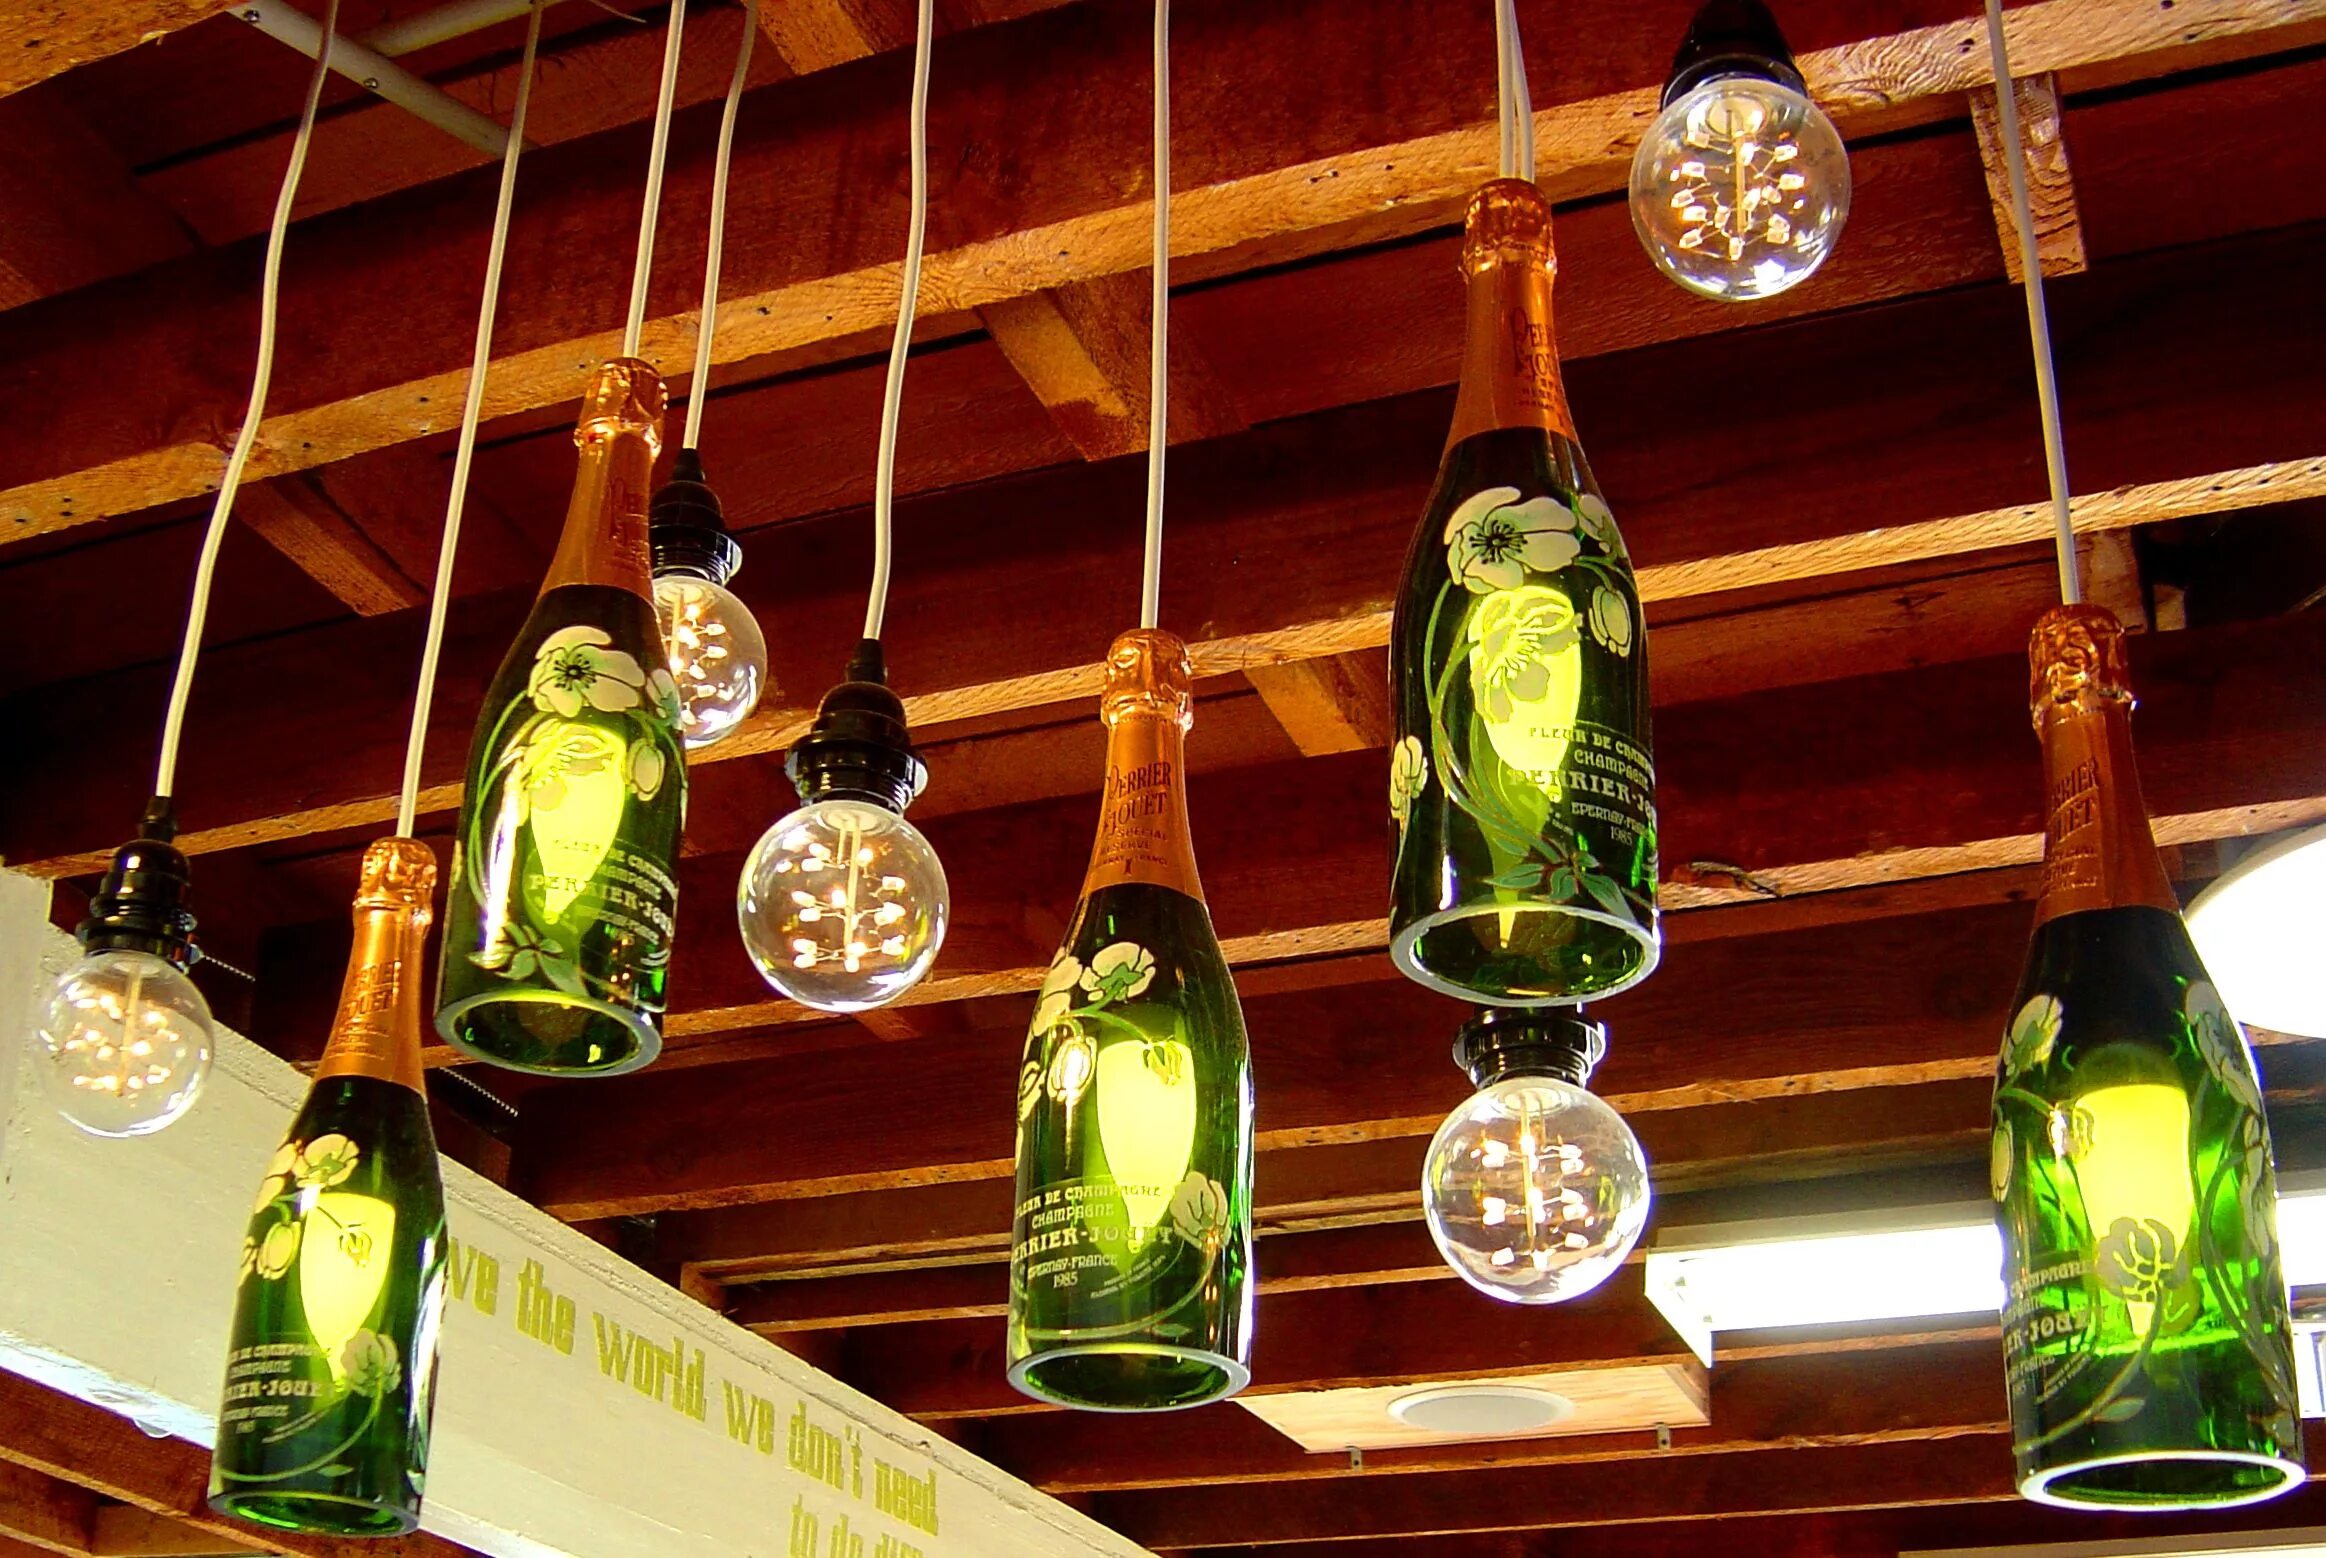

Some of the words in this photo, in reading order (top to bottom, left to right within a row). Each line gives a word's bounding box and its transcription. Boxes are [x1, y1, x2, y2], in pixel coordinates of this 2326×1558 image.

[1592, 732, 1612, 750] DE
[1107, 762, 1171, 799] PERRIER
[1610, 825, 1634, 846] 1985
[1045, 1189, 1061, 1204] DE
[1031, 1203, 1114, 1230] CHAMPAGNE
[1053, 1271, 1079, 1289] 1985
[515, 1257, 577, 1357] the
[592, 1311, 707, 1423] world
[721, 1378, 775, 1456] we
[787, 1399, 863, 1500] don't
[874, 1457, 939, 1537] need
[789, 1493, 819, 1558] to
